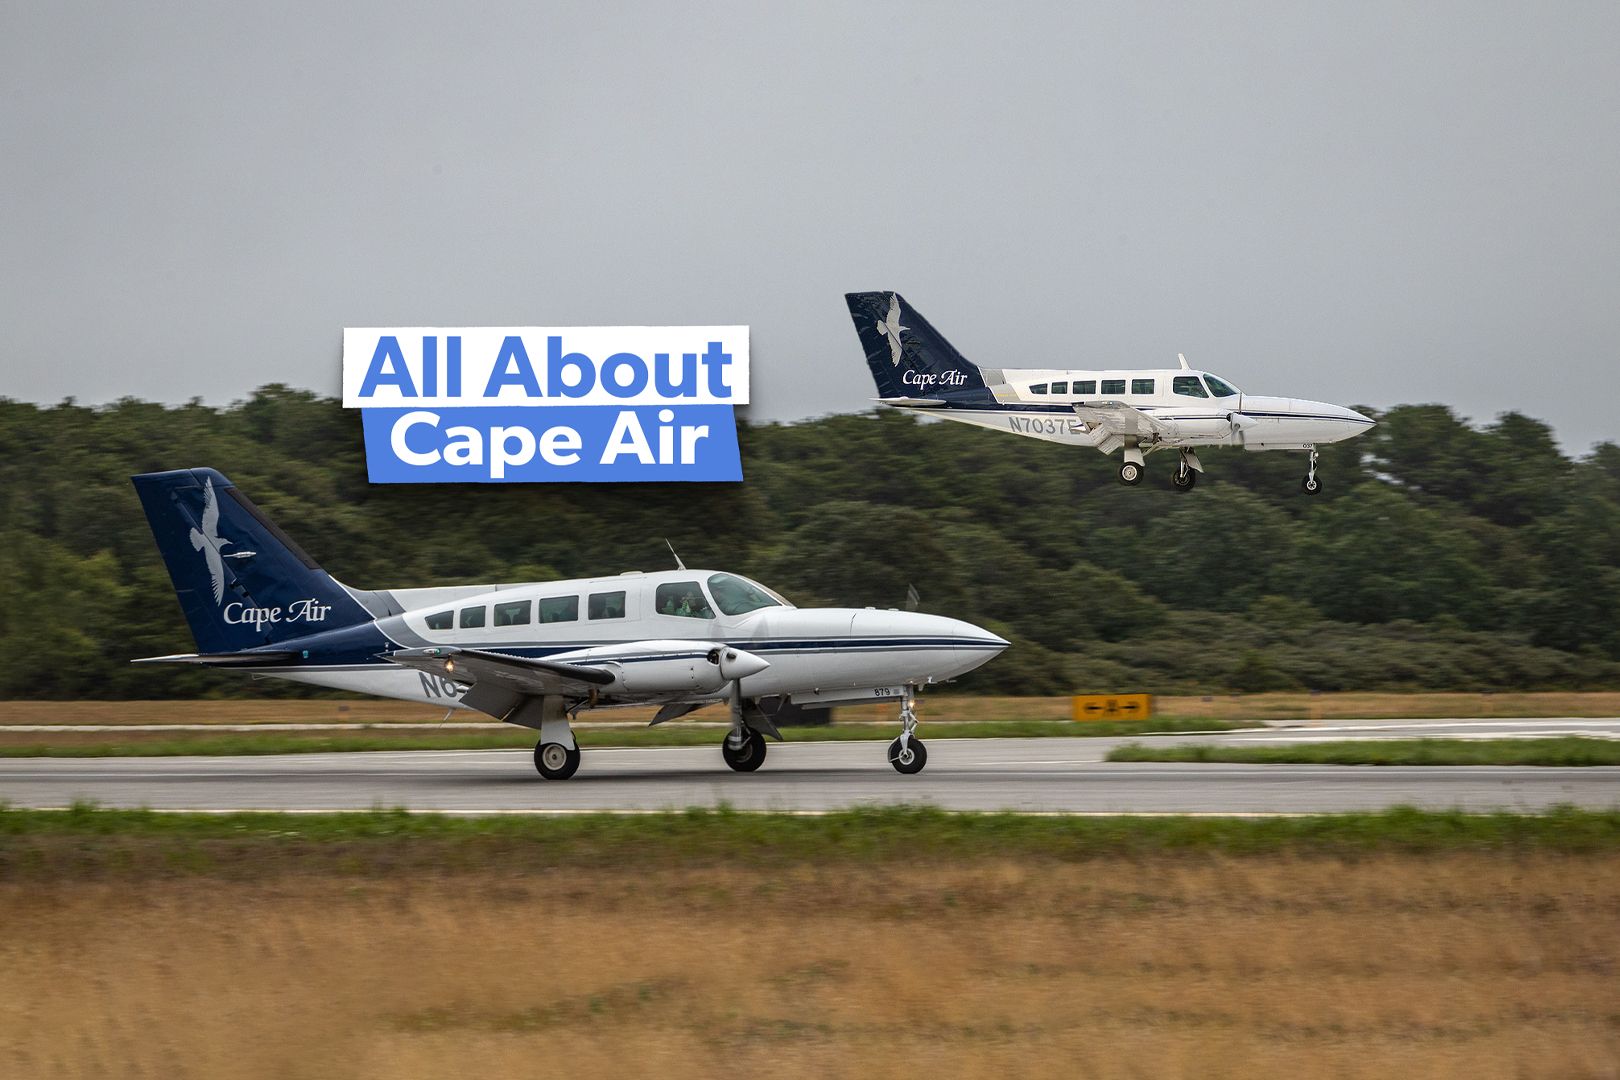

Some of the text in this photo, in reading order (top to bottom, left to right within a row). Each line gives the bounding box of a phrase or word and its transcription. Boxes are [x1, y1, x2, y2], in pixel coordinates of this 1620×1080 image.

[902, 369, 968, 390] Cape Air
[223, 598, 332, 632] Cape Air
[874, 687, 891, 697] 879
